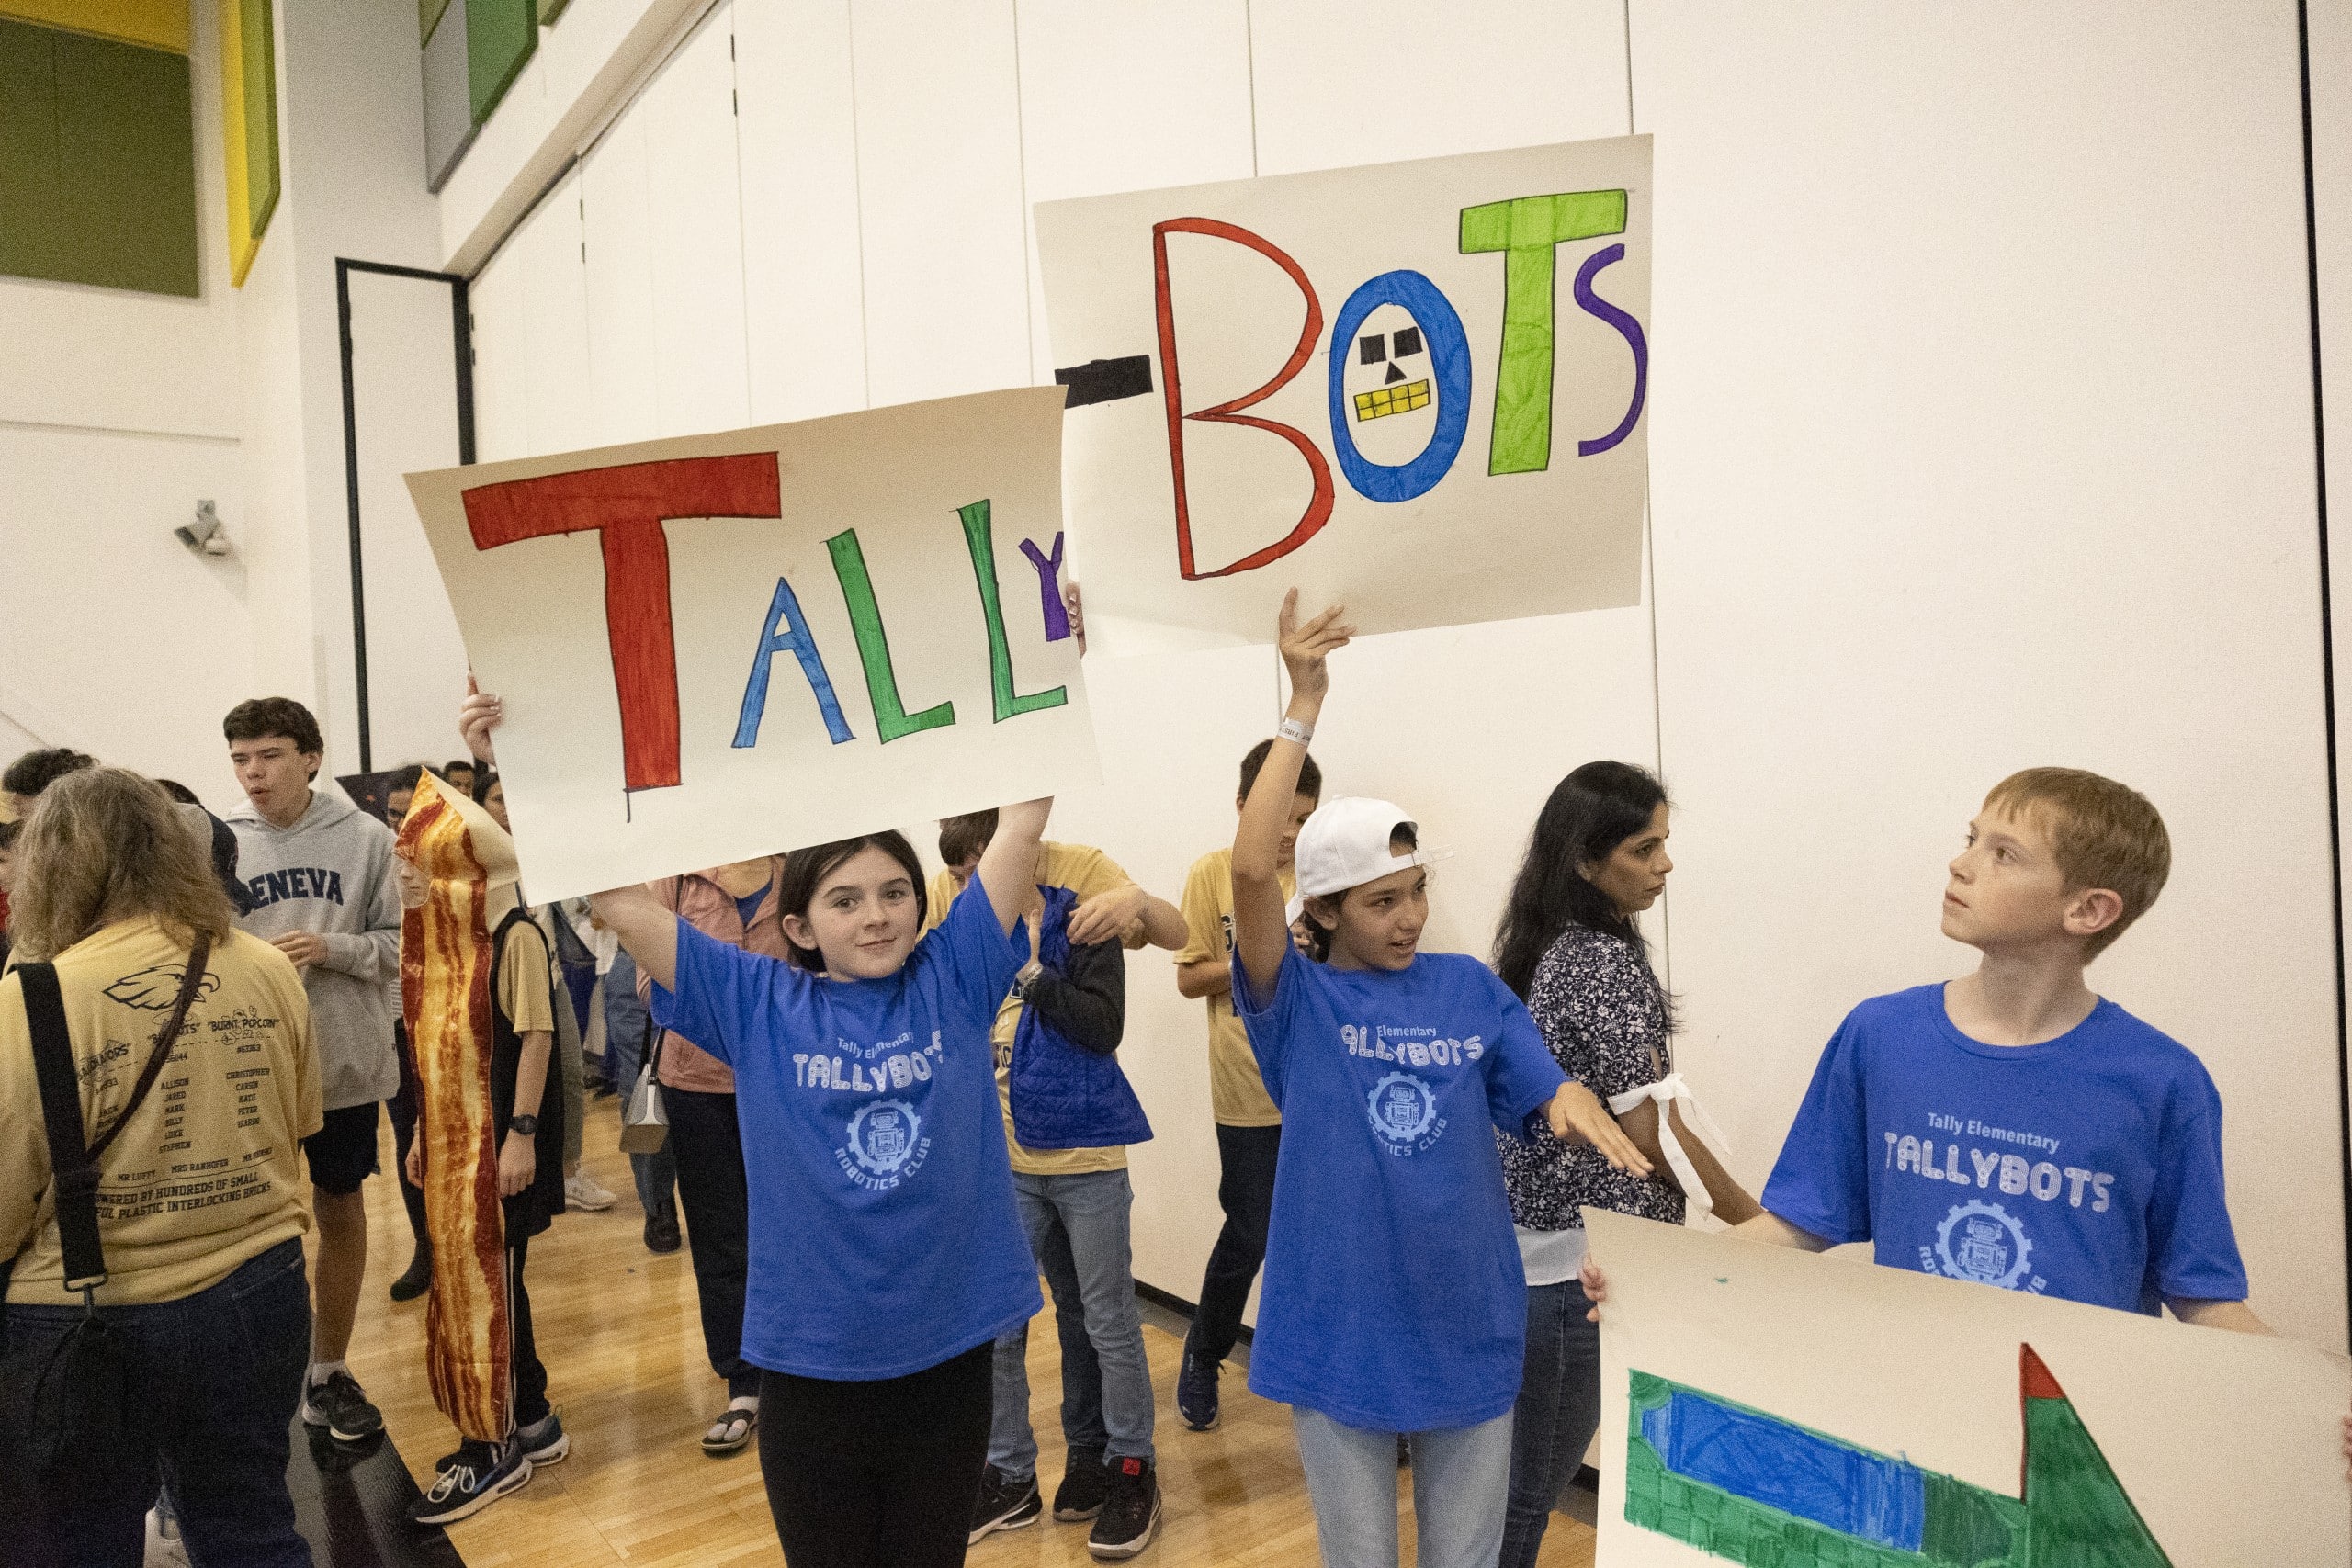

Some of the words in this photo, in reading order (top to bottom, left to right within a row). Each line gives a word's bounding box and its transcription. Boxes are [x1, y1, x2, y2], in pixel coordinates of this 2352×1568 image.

[462, 451, 1071, 793] TALLY
[241, 867, 344, 917] ENEVA
[837, 1037, 862, 1058] Tally
[1340, 1024, 1484, 1066] ALLYBOTS
[1376, 1025, 1437, 1038] Elementary
[1928, 1111, 1964, 1136] Tally
[1966, 1120, 2061, 1155] Elementary
[834, 1147, 899, 1190] ROBOTICS
[903, 1137, 932, 1179] CLUB
[1883, 1131, 2115, 1213] TALLYBOTS
[94, 1193, 138, 1205] OWERED
[140, 1190, 153, 1201] BY
[155, 1180, 214, 1199] HUNDREDS
[216, 1178, 228, 1191] OF
[230, 1171, 260, 1188] SMALL
[118, 1202, 164, 1220] PLASTIC
[167, 1190, 242, 1212] INTERLOCKING
[243, 1180, 272, 1199] BRICKS
